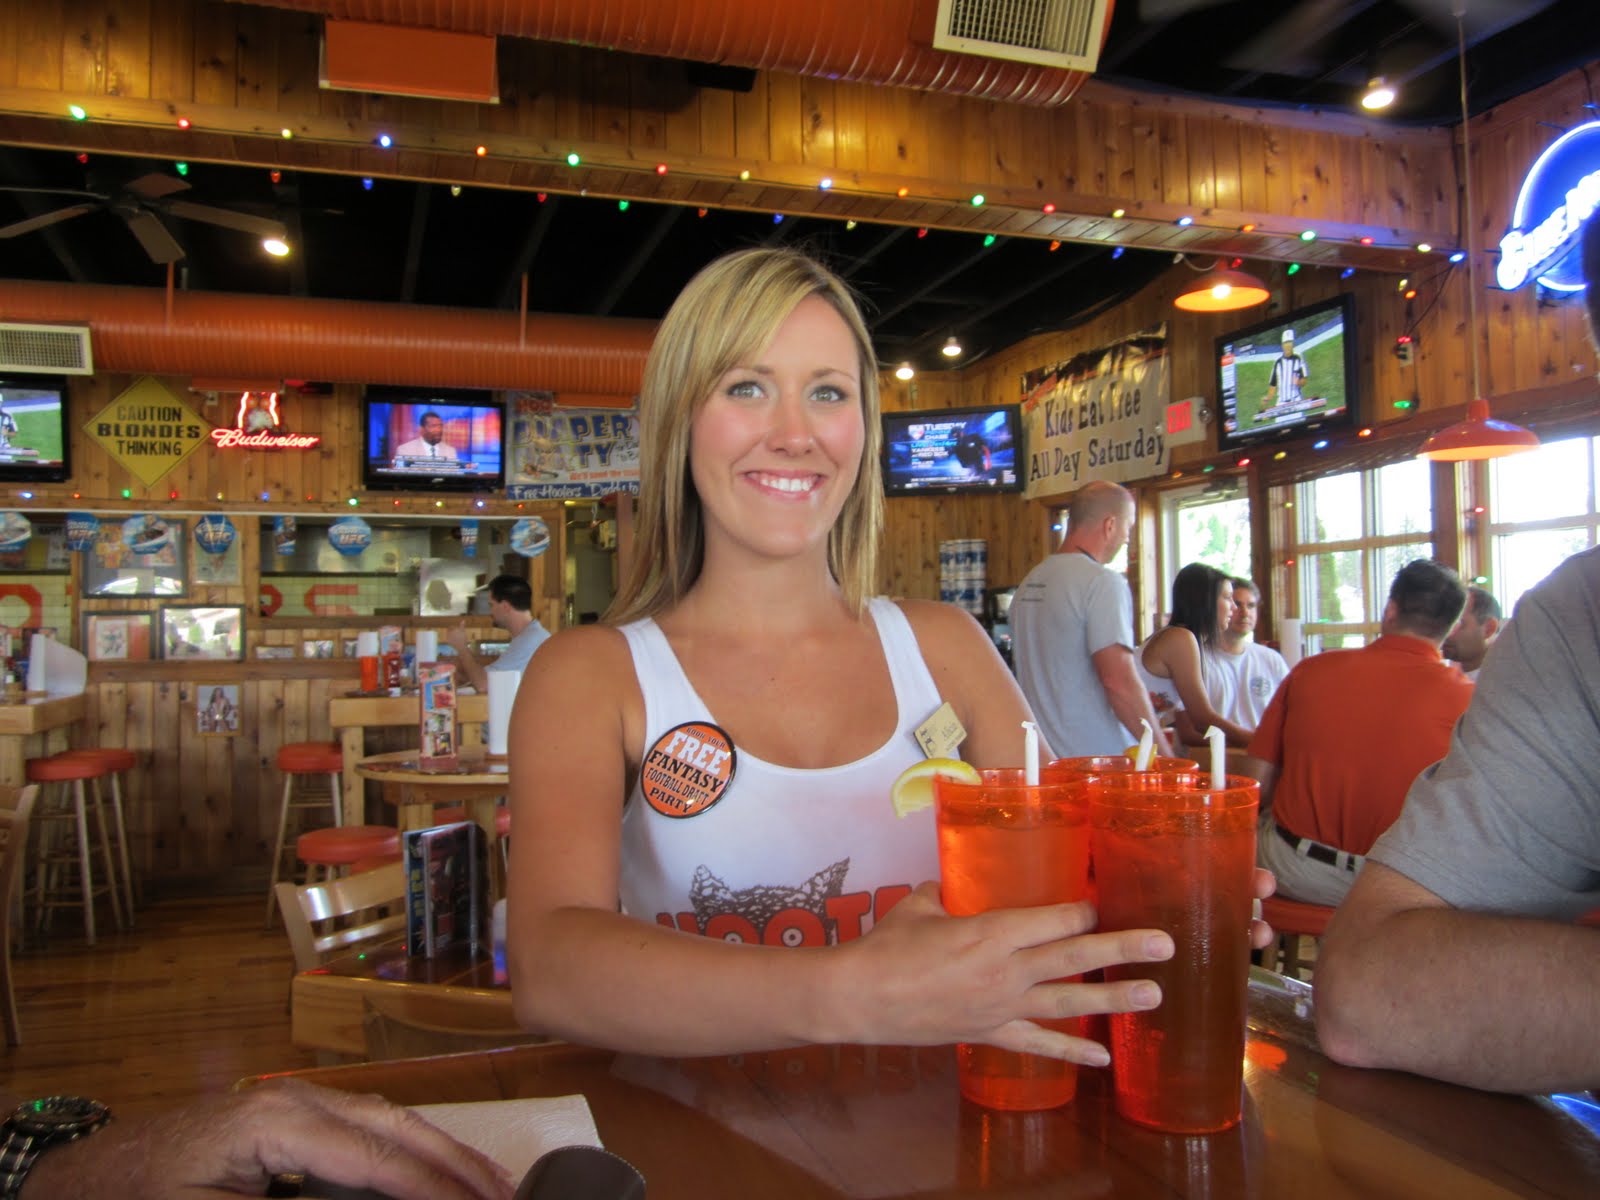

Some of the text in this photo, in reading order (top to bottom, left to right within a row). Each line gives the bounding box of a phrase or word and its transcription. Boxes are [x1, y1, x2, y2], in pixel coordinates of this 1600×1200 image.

[117, 406, 182, 421] CAUTION
[1045, 398, 1073, 438] Kids
[1078, 388, 1104, 430] Eat
[97, 423, 200, 439] BLONDES
[210, 428, 320, 448] Budweiser
[117, 441, 182, 456] THINKING
[1030, 451, 1048, 481] All
[1054, 447, 1081, 481] Day
[1088, 428, 1165, 467] Saturday
[339, 534, 370, 545] UFC
[664, 731, 729, 775] FREE
[648, 750, 723, 792] FANTASY
[645, 767, 709, 805] FOOTBALL DRAFT
[649, 786, 692, 813] PARTY
